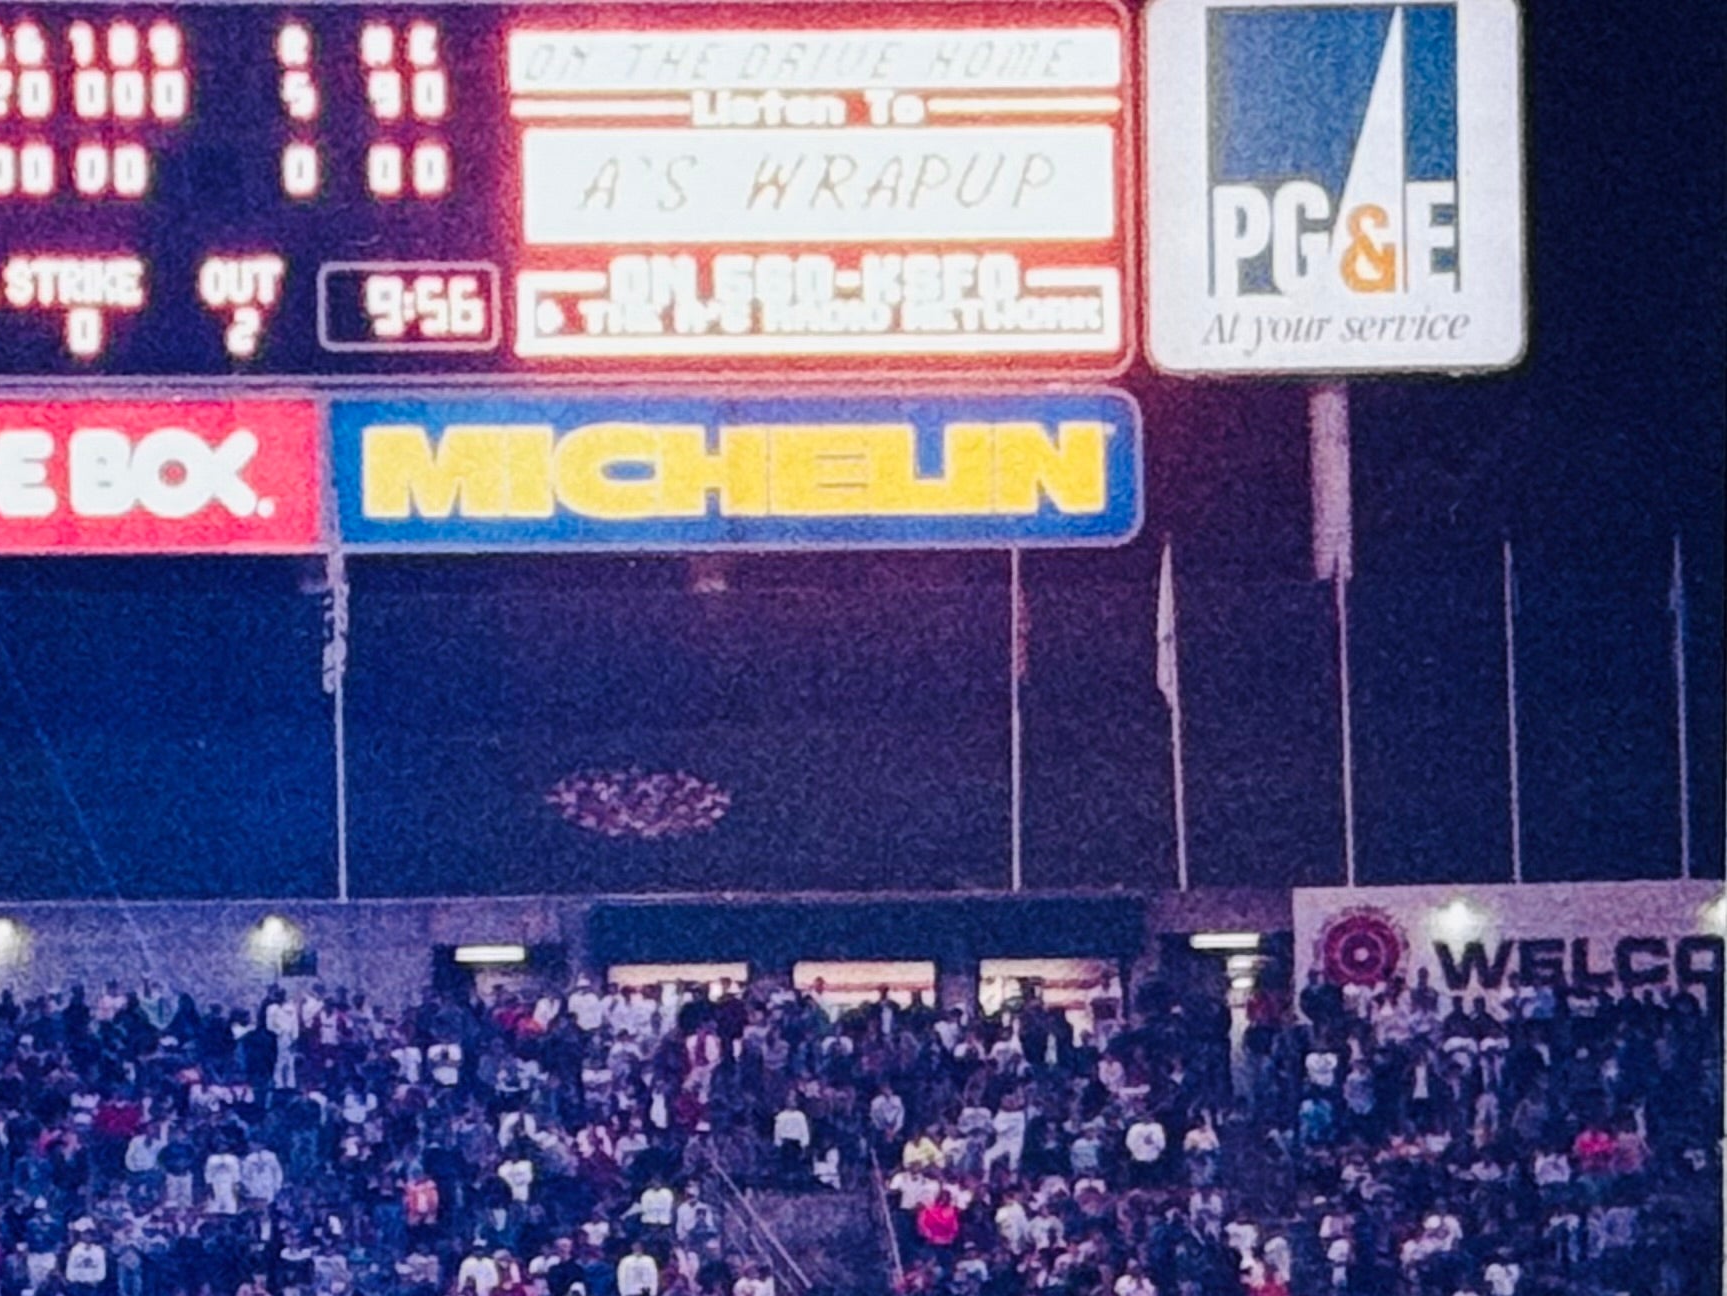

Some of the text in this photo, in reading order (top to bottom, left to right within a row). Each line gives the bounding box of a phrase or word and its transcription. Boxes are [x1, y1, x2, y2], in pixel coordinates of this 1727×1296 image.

[626, 41, 719, 81] THE
[738, 40, 904, 81] DRIVE
[690, 87, 925, 126] Listen To
[577, 153, 1056, 211] A'S WRAPUP
[1210, 179, 1459, 298] PG&E
[4, 257, 143, 305] STRIKE
[200, 257, 283, 304] OUT
[367, 278, 484, 335] 9:56
[67, 307, 101, 354] 0
[226, 307, 260, 354] 2
[1243, 314, 1332, 357] your
[1338, 304, 1472, 343] service
[361, 421, 1107, 520] MICHELIN
